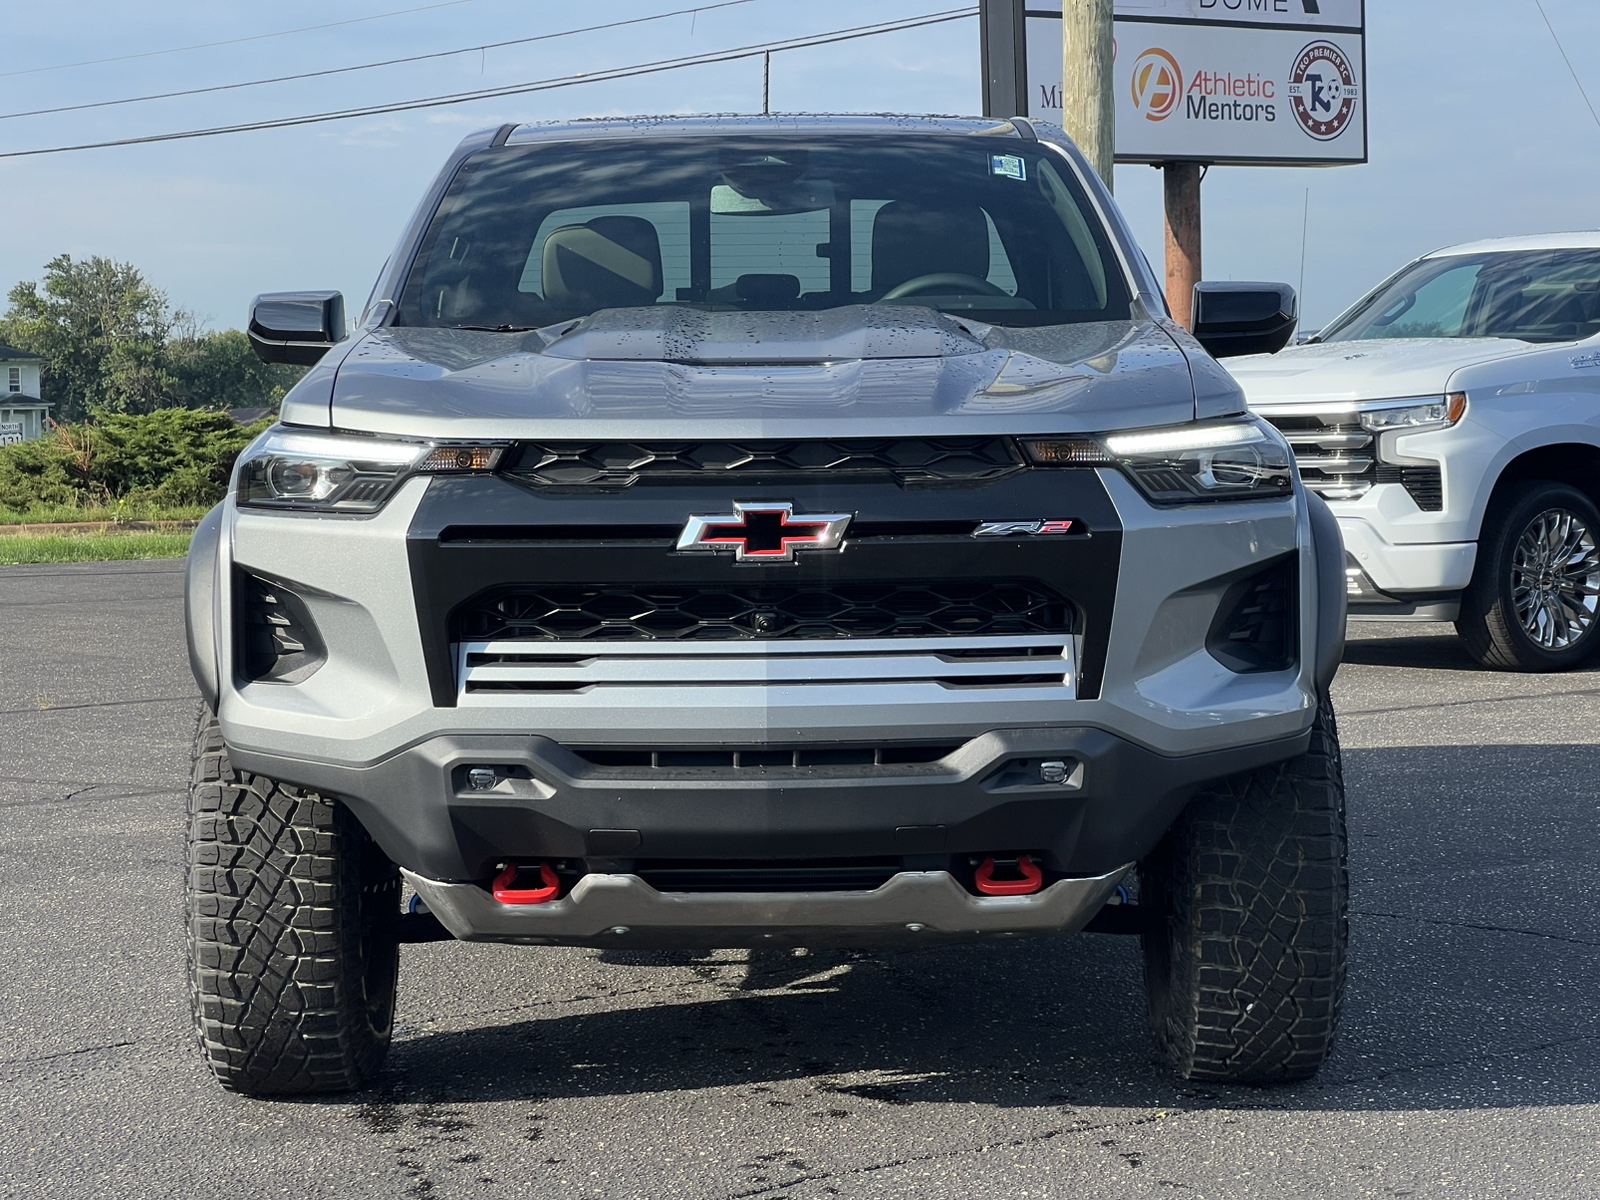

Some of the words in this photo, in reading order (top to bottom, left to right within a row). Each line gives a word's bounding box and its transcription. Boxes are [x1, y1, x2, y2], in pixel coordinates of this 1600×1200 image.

[1296, 57, 1309, 75] TKO
[1309, 48, 1341, 66] PREMIER
[1340, 64, 1349, 78] SC
[1187, 70, 1275, 99] Athletic
[1289, 86, 1302, 94] EST.
[1343, 88, 1358, 96] 1983
[1186, 94, 1276, 122] Mentors
[972, 520, 1073, 536] ZR2
